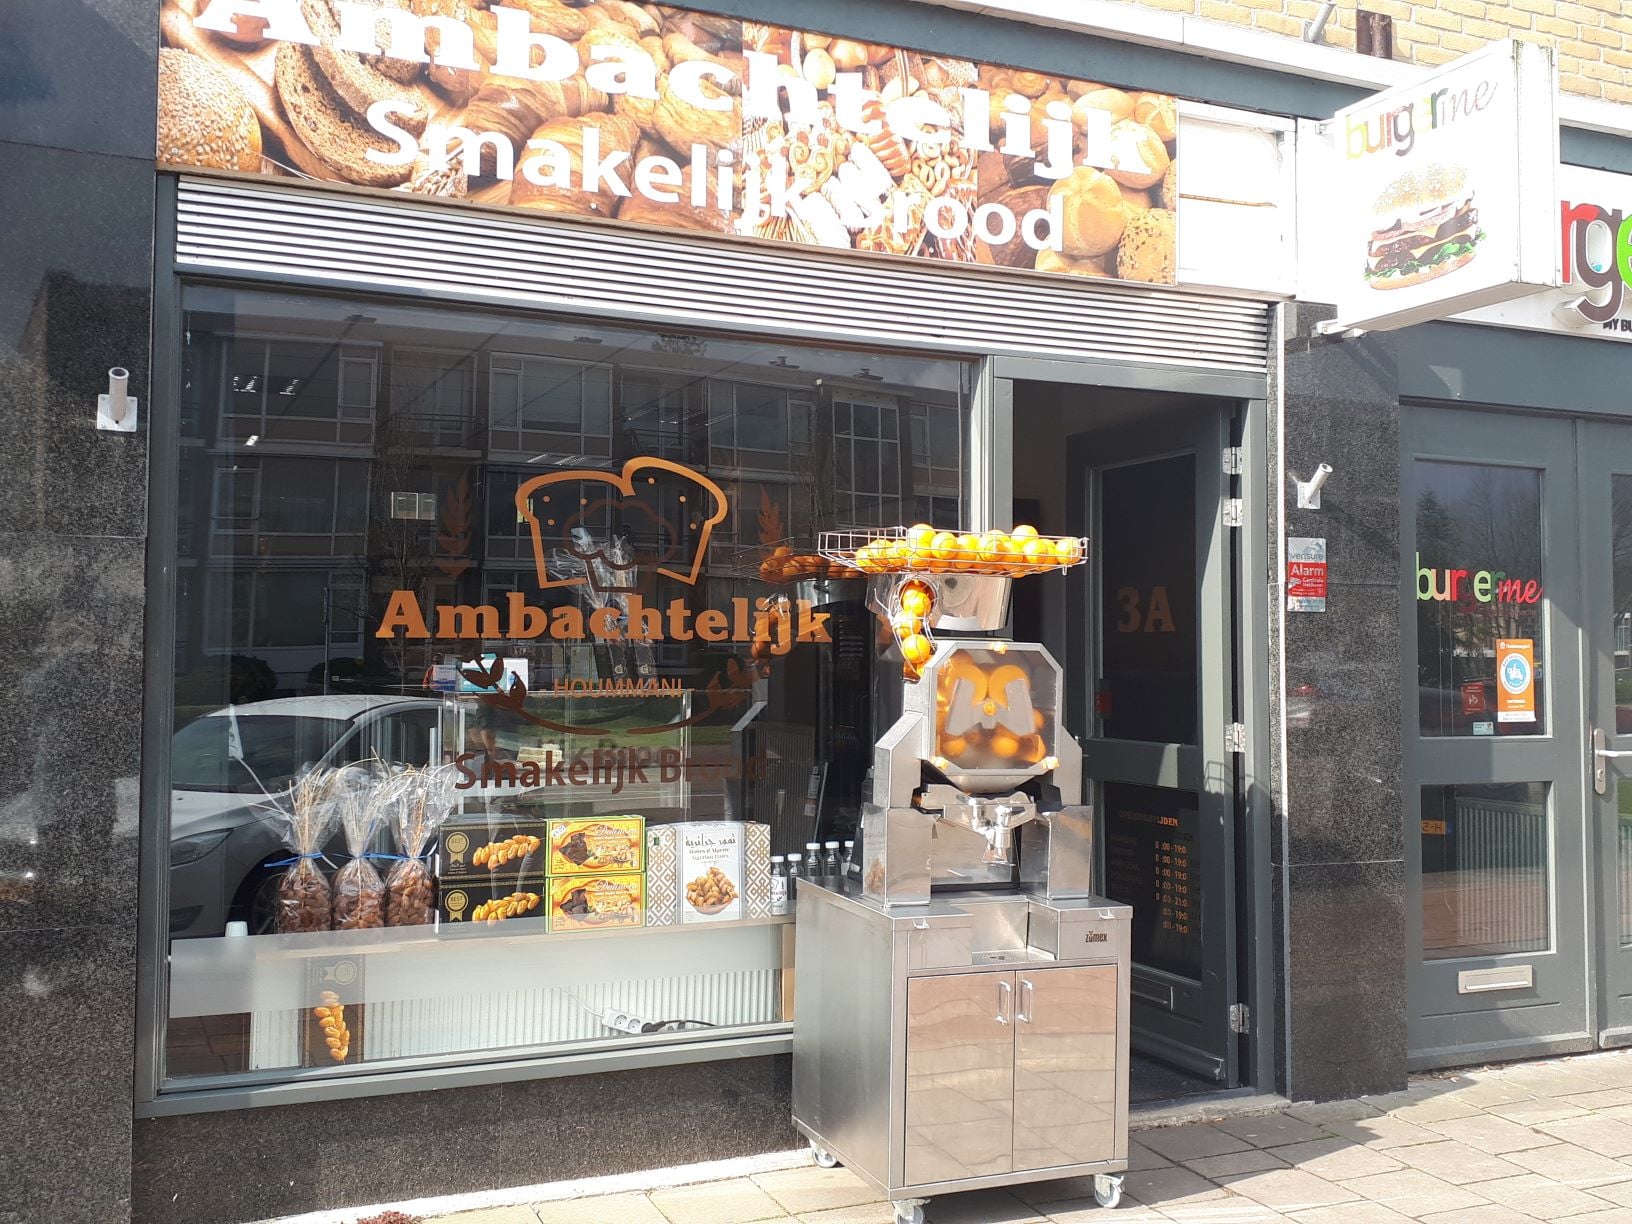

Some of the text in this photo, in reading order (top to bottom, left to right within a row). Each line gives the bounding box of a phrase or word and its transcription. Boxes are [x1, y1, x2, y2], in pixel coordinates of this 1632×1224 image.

[193, 0, 1152, 180] Ambachtelijk
[365, 99, 1064, 252] Smakelijk rood
[1290, 552, 1324, 561] verisure
[1290, 564, 1324, 576] Alarm
[1416, 551, 1543, 614] burgerme
[376, 590, 833, 655] Ambachtelijk
[1117, 585, 1177, 634] 3A
[553, 677, 683, 698] HOUMMANI
[454, 747, 649, 795] Smakelijk
